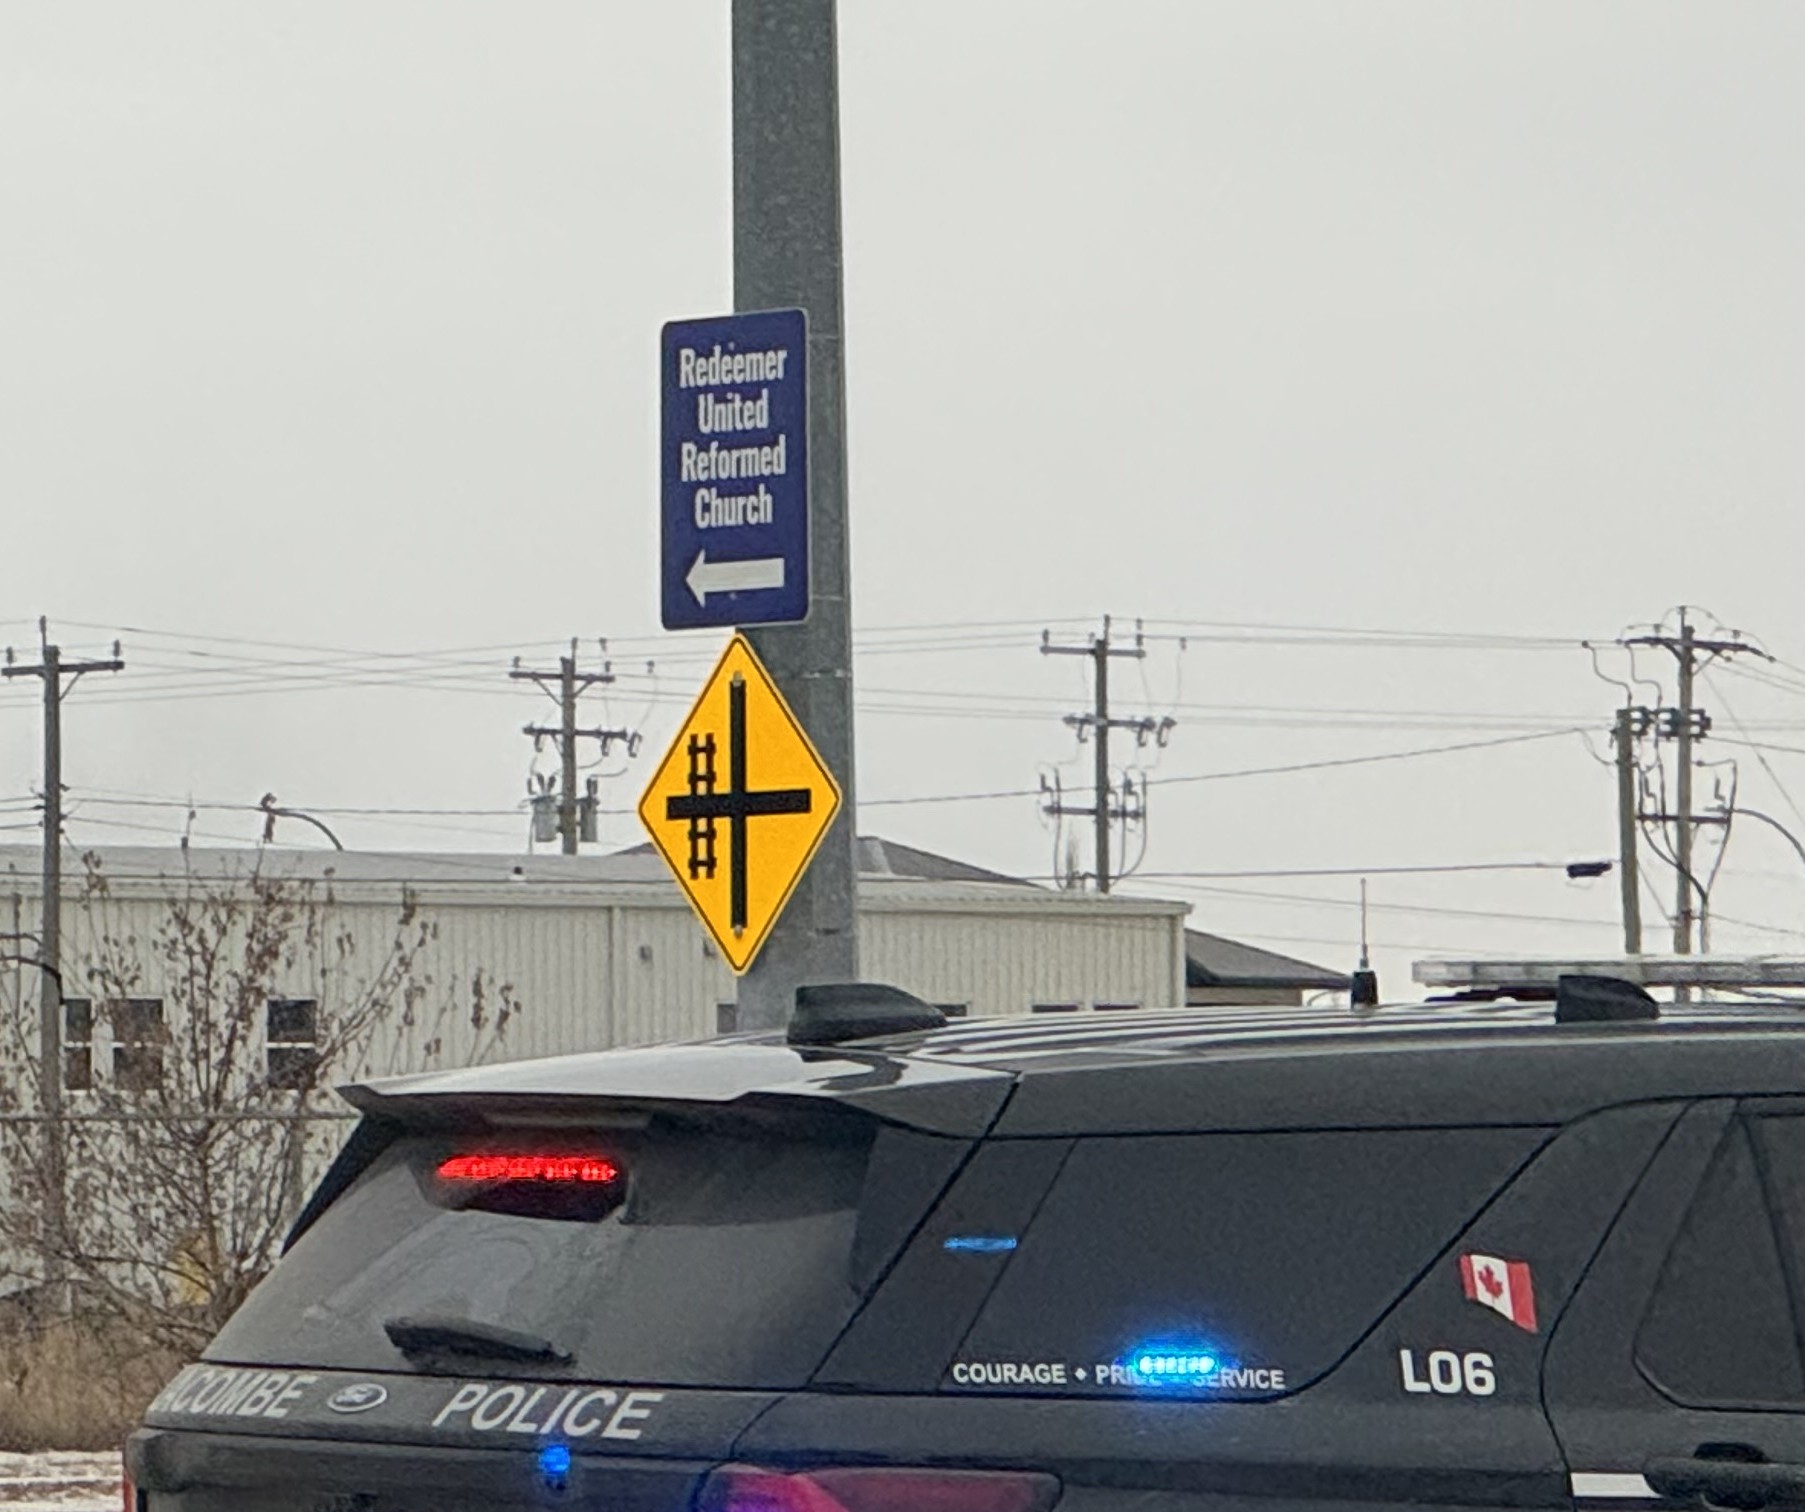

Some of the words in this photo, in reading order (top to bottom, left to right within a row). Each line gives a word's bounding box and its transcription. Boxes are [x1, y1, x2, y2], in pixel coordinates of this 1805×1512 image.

[679, 345, 788, 389] Redeemer
[698, 388, 769, 434] United
[681, 434, 786, 482] Reformed
[695, 483, 773, 529] Church
[952, 1362, 1067, 1384] COURAGE
[1096, 1364, 1163, 1388] PRI
[150, 1371, 318, 1418] ACOMBE
[432, 1383, 665, 1440] POLICE
